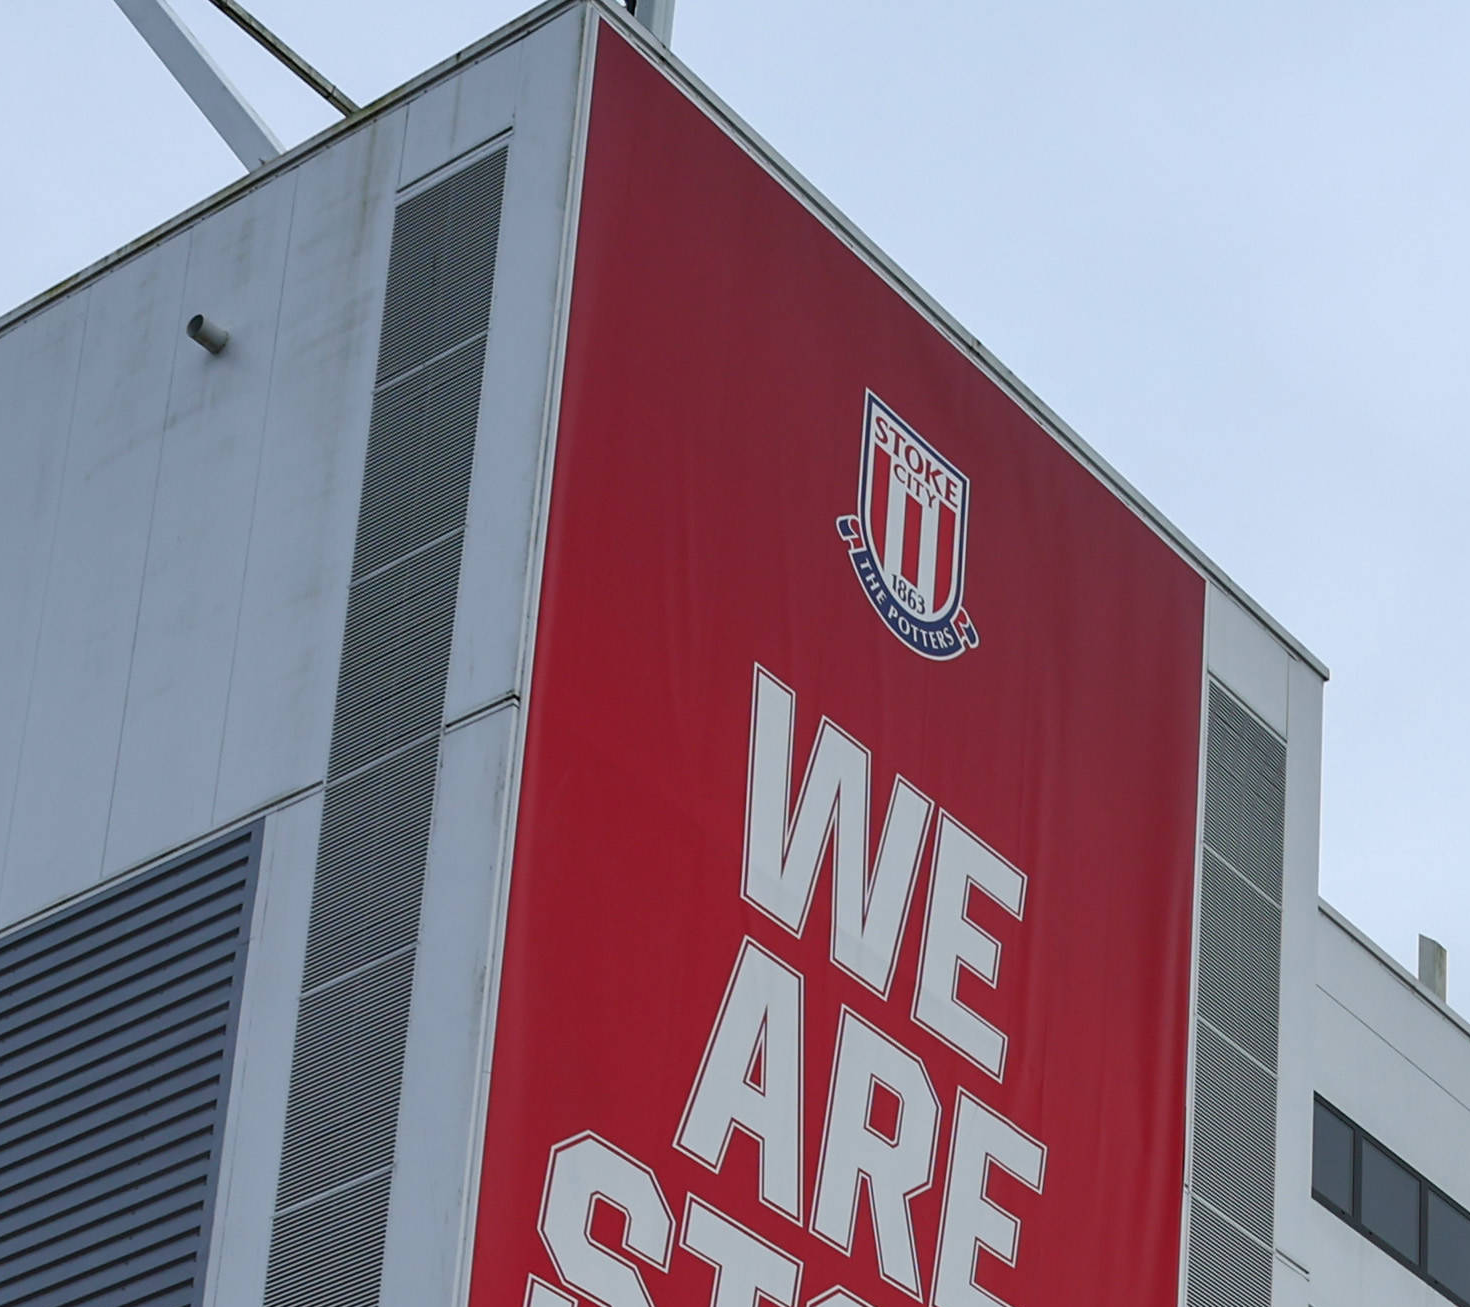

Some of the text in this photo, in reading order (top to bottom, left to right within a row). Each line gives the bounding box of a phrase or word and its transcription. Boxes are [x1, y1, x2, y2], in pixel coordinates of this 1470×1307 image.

[875, 415, 958, 508] STOKE
[893, 463, 936, 509] CITY
[860, 558, 955, 650] THE POTTERS
[891, 573, 925, 615] 1863
[741, 661, 1028, 1083] WE
